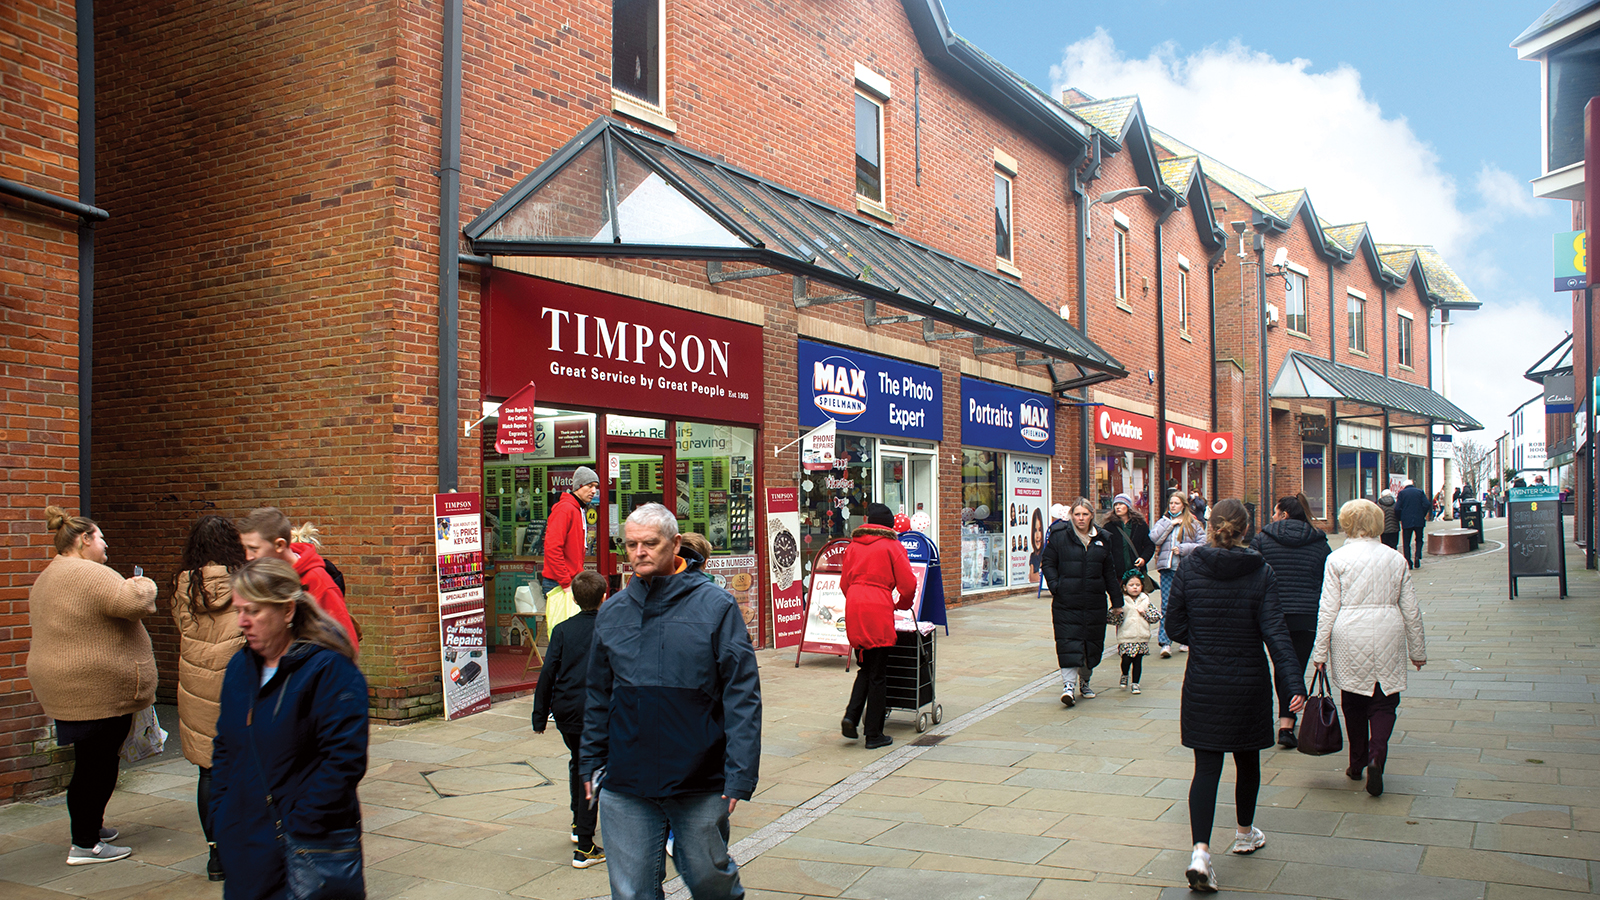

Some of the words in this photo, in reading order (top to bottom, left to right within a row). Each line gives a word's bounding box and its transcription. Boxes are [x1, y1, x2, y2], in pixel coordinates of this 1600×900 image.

[541, 307, 730, 378] TIMPSON
[550, 361, 587, 378] Great
[591, 367, 636, 385] Service
[640, 374, 654, 390] by
[658, 376, 688, 392] Great
[691, 381, 725, 398] People
[728, 390, 737, 398] Est
[738, 391, 749, 400] 1903
[814, 361, 866, 398] MAX
[878, 371, 900, 395] The
[902, 376, 933, 401] Photo
[819, 396, 862, 411] SPIELMANN
[1547, 394, 1572, 402] Clarks
[889, 403, 925, 431] Expert
[969, 397, 1013, 428] Portraits
[1020, 403, 1049, 429] MAX
[649, 427, 693, 439] Reirs
[1023, 429, 1046, 439] SPIELMANN
[1111, 418, 1143, 440] vodafone
[676, 437, 725, 451] ngraving
[1175, 433, 1199, 451] vodafone
[1014, 461, 1021, 473] 10
[1022, 462, 1043, 475] Picture
[551, 476, 573, 486] Watc
[1514, 511, 1530, 522] SIM
[460, 528, 478, 536] PRICE
[821, 546, 847, 561] TIMP
[707, 560, 720, 568] GNS
[726, 558, 753, 567] NUMBERS
[816, 581, 835, 590] CAR
[446, 592, 468, 600] SPECIALIST
[775, 596, 801, 609] Watch
[455, 619, 466, 627] ASK
[467, 615, 484, 624] ABOUT
[777, 613, 801, 623] Repairs
[447, 625, 459, 633] Car
[446, 634, 483, 647] Repairs
